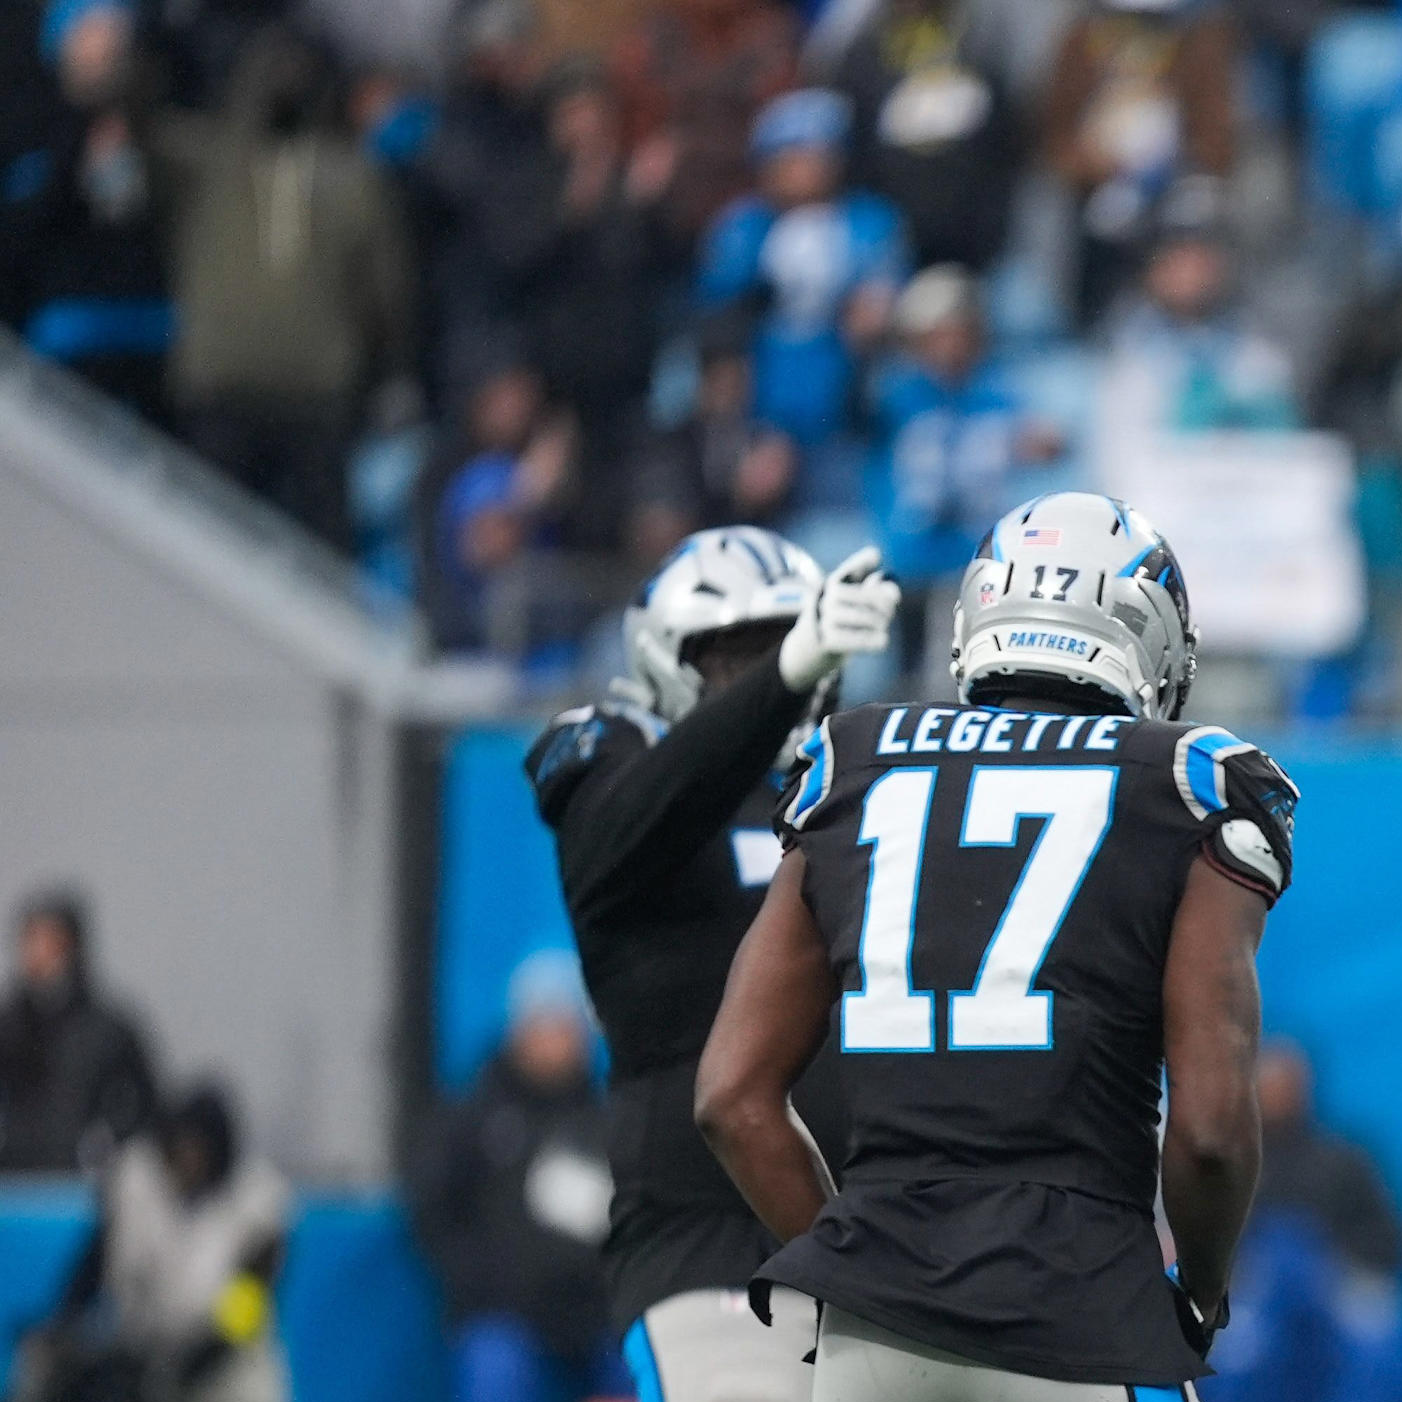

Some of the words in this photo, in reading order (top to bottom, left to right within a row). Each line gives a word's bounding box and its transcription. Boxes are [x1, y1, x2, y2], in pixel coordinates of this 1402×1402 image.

[1030, 565, 1079, 601] 17
[1008, 632, 1087, 655] PANTHERS
[877, 707, 1134, 753] LEGETTE
[841, 765, 1120, 1053] 17
